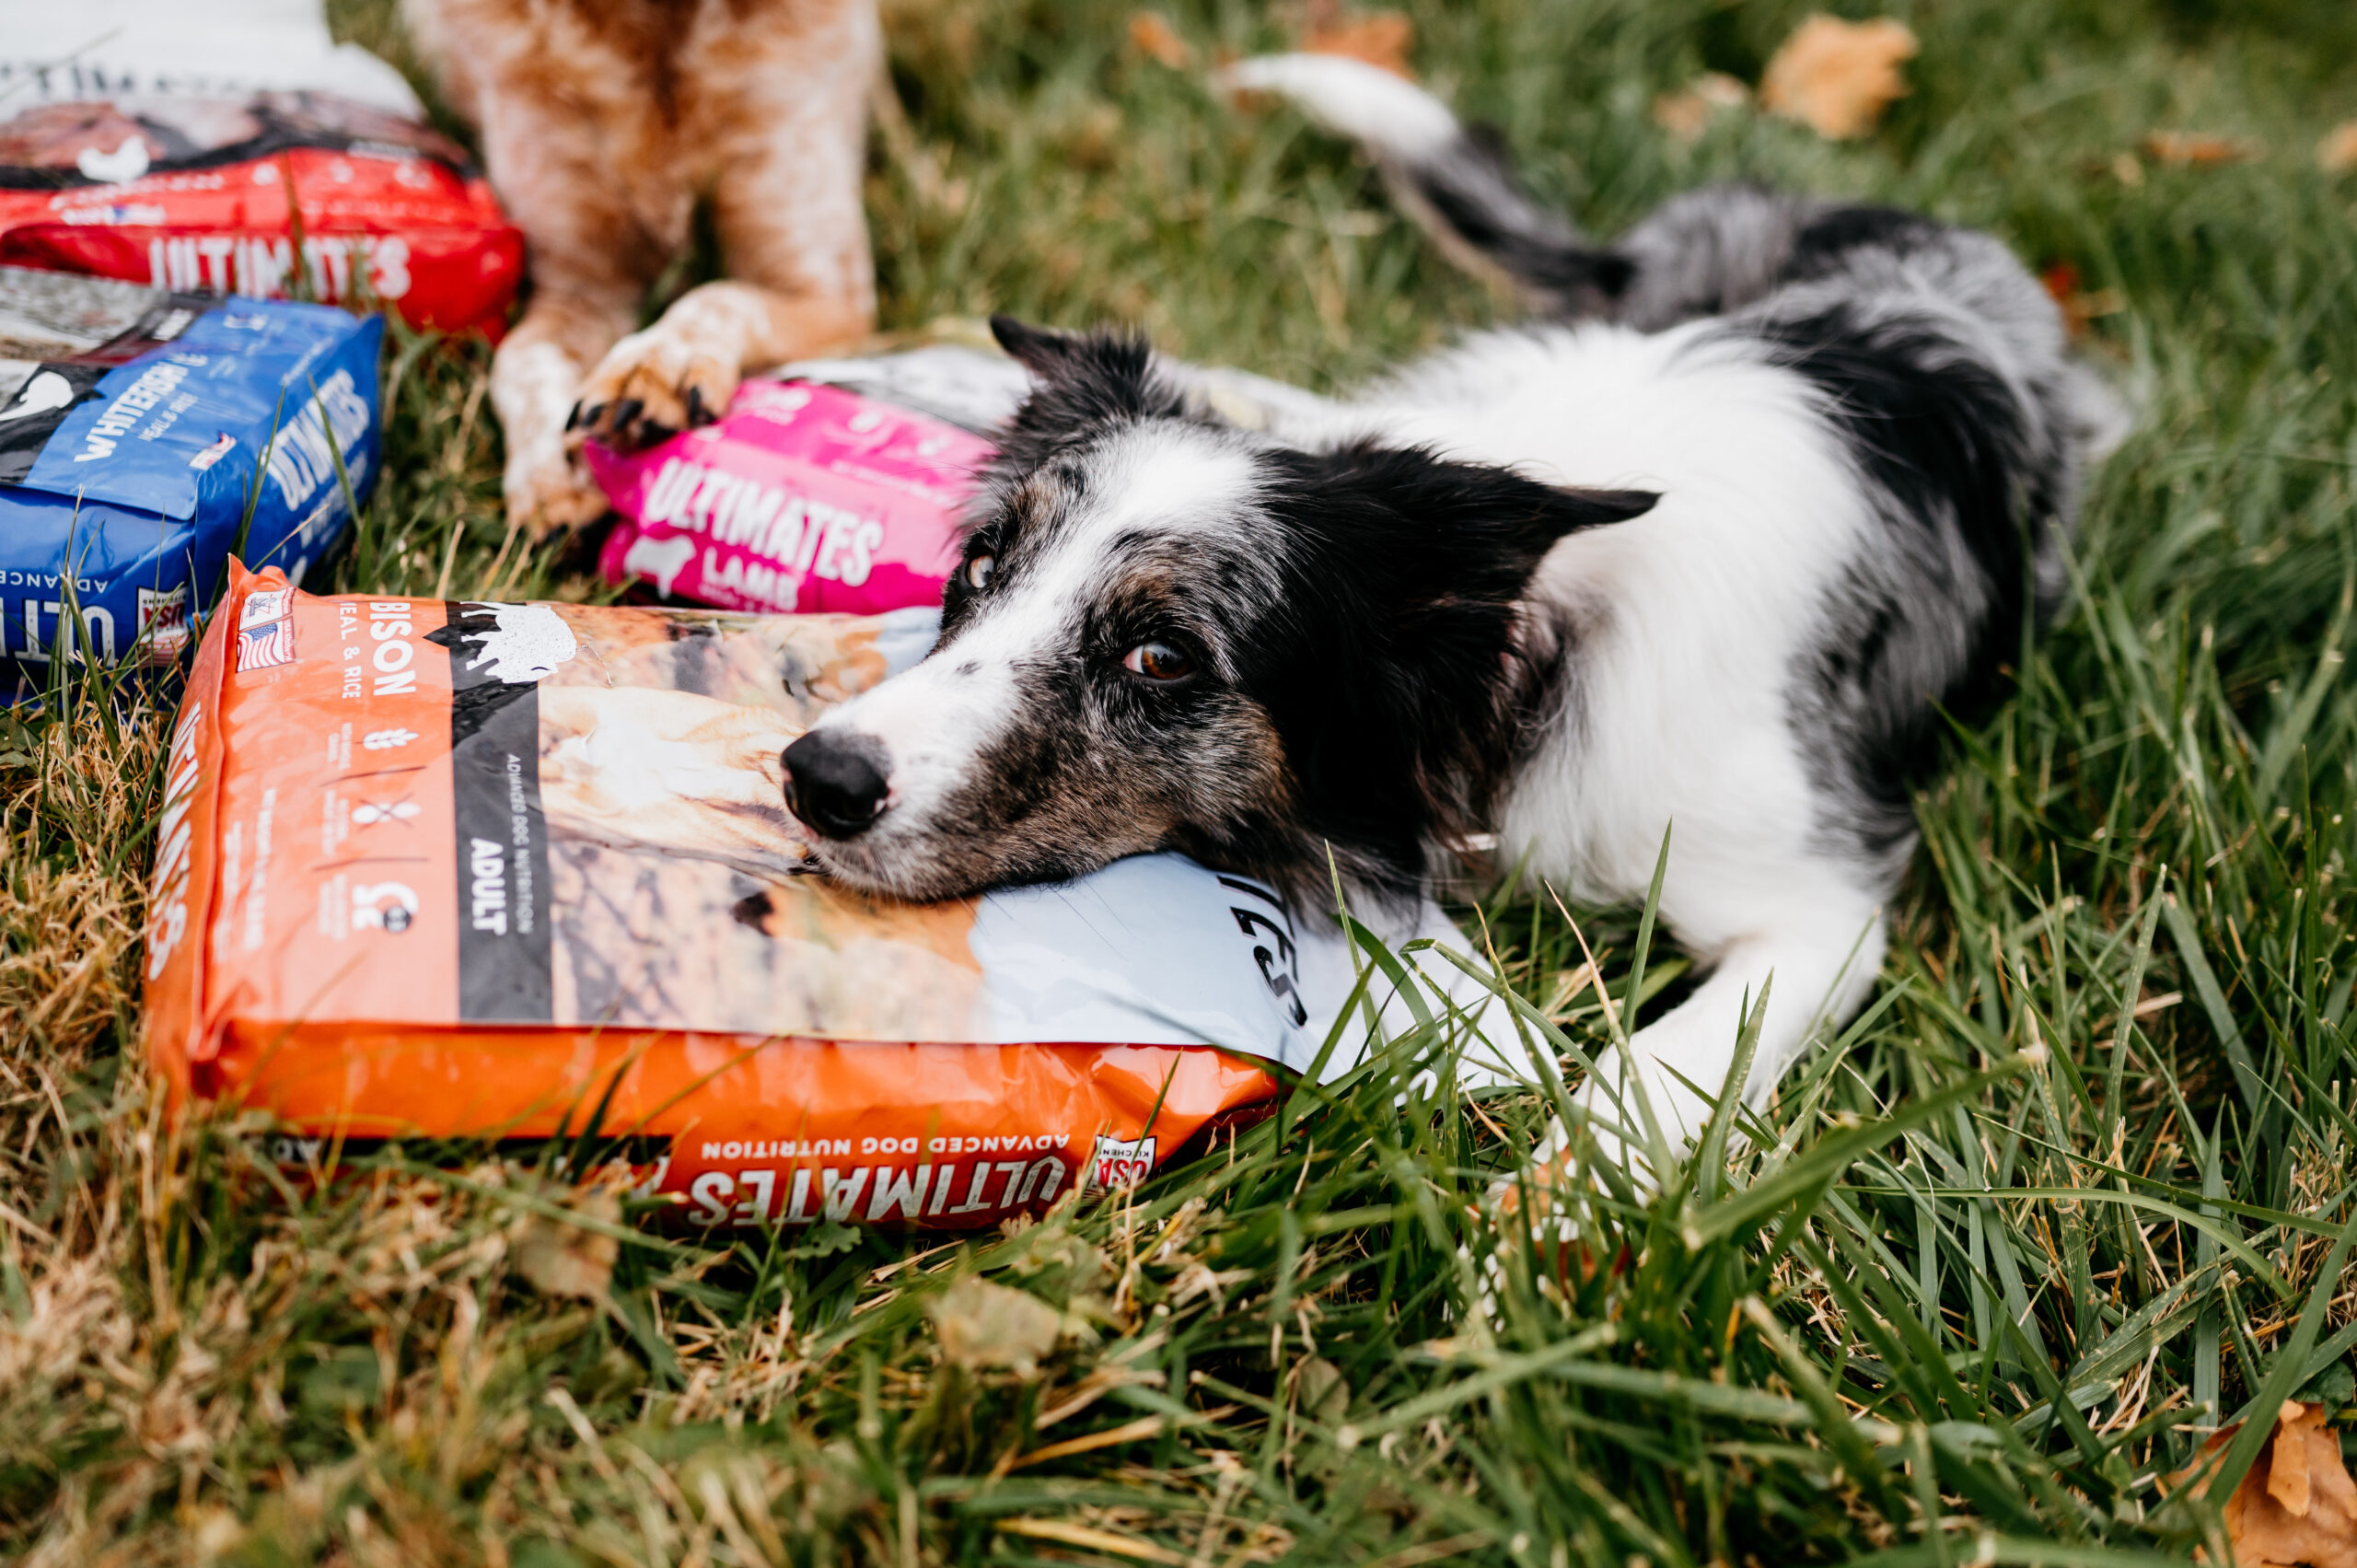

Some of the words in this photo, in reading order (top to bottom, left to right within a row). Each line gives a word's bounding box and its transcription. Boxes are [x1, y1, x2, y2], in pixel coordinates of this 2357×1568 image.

[646, 457, 884, 587] ULTIMATES
[0, 570, 108, 594] ADANCE
[702, 545, 798, 612] LAMB
[144, 603, 184, 633] USA
[343, 646, 361, 661] &
[369, 601, 417, 697] BISON
[342, 666, 363, 700] RICE
[470, 837, 507, 935] ADULT
[515, 849, 534, 935] NUTRITION
[702, 1139, 851, 1160] NUTRITION
[862, 1137, 918, 1155] DOG
[928, 1134, 1071, 1153] ADVANCED
[1098, 1148, 1149, 1157] KICHEN
[1097, 1158, 1147, 1187] USA
[687, 1156, 1066, 1226] ULTIMATES
